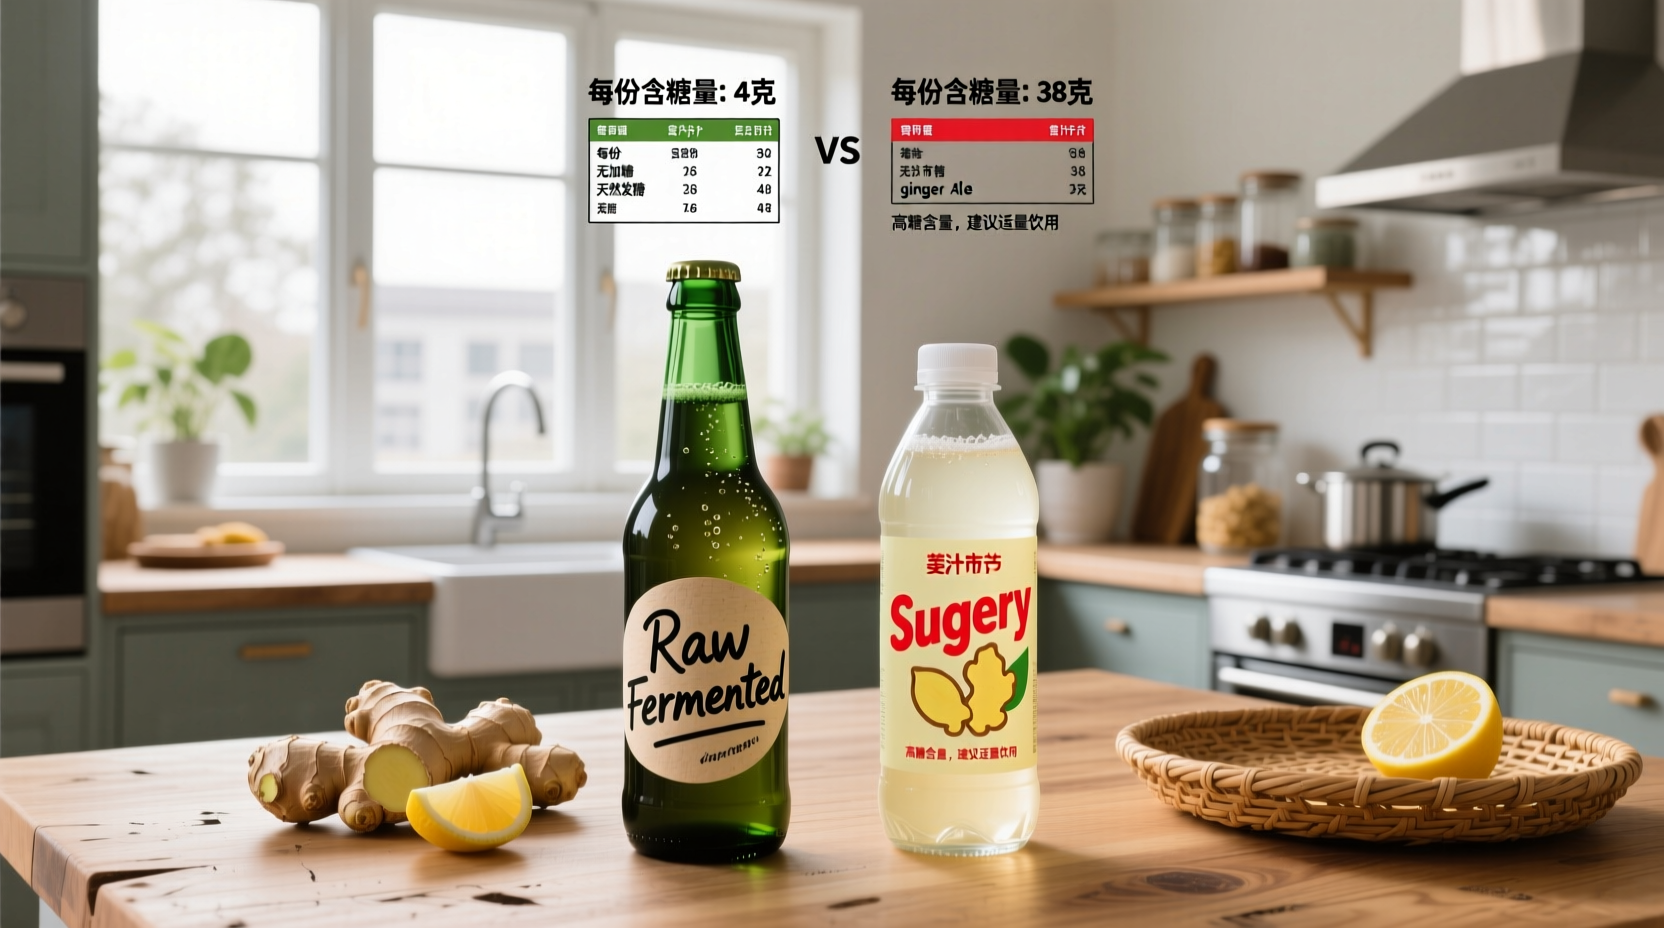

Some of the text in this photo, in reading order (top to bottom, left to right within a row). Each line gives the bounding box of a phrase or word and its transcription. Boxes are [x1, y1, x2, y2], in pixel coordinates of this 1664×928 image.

[642, 608, 750, 675] Raw
[889, 586, 1032, 657] Sugery
[627, 648, 786, 731] Fermented
